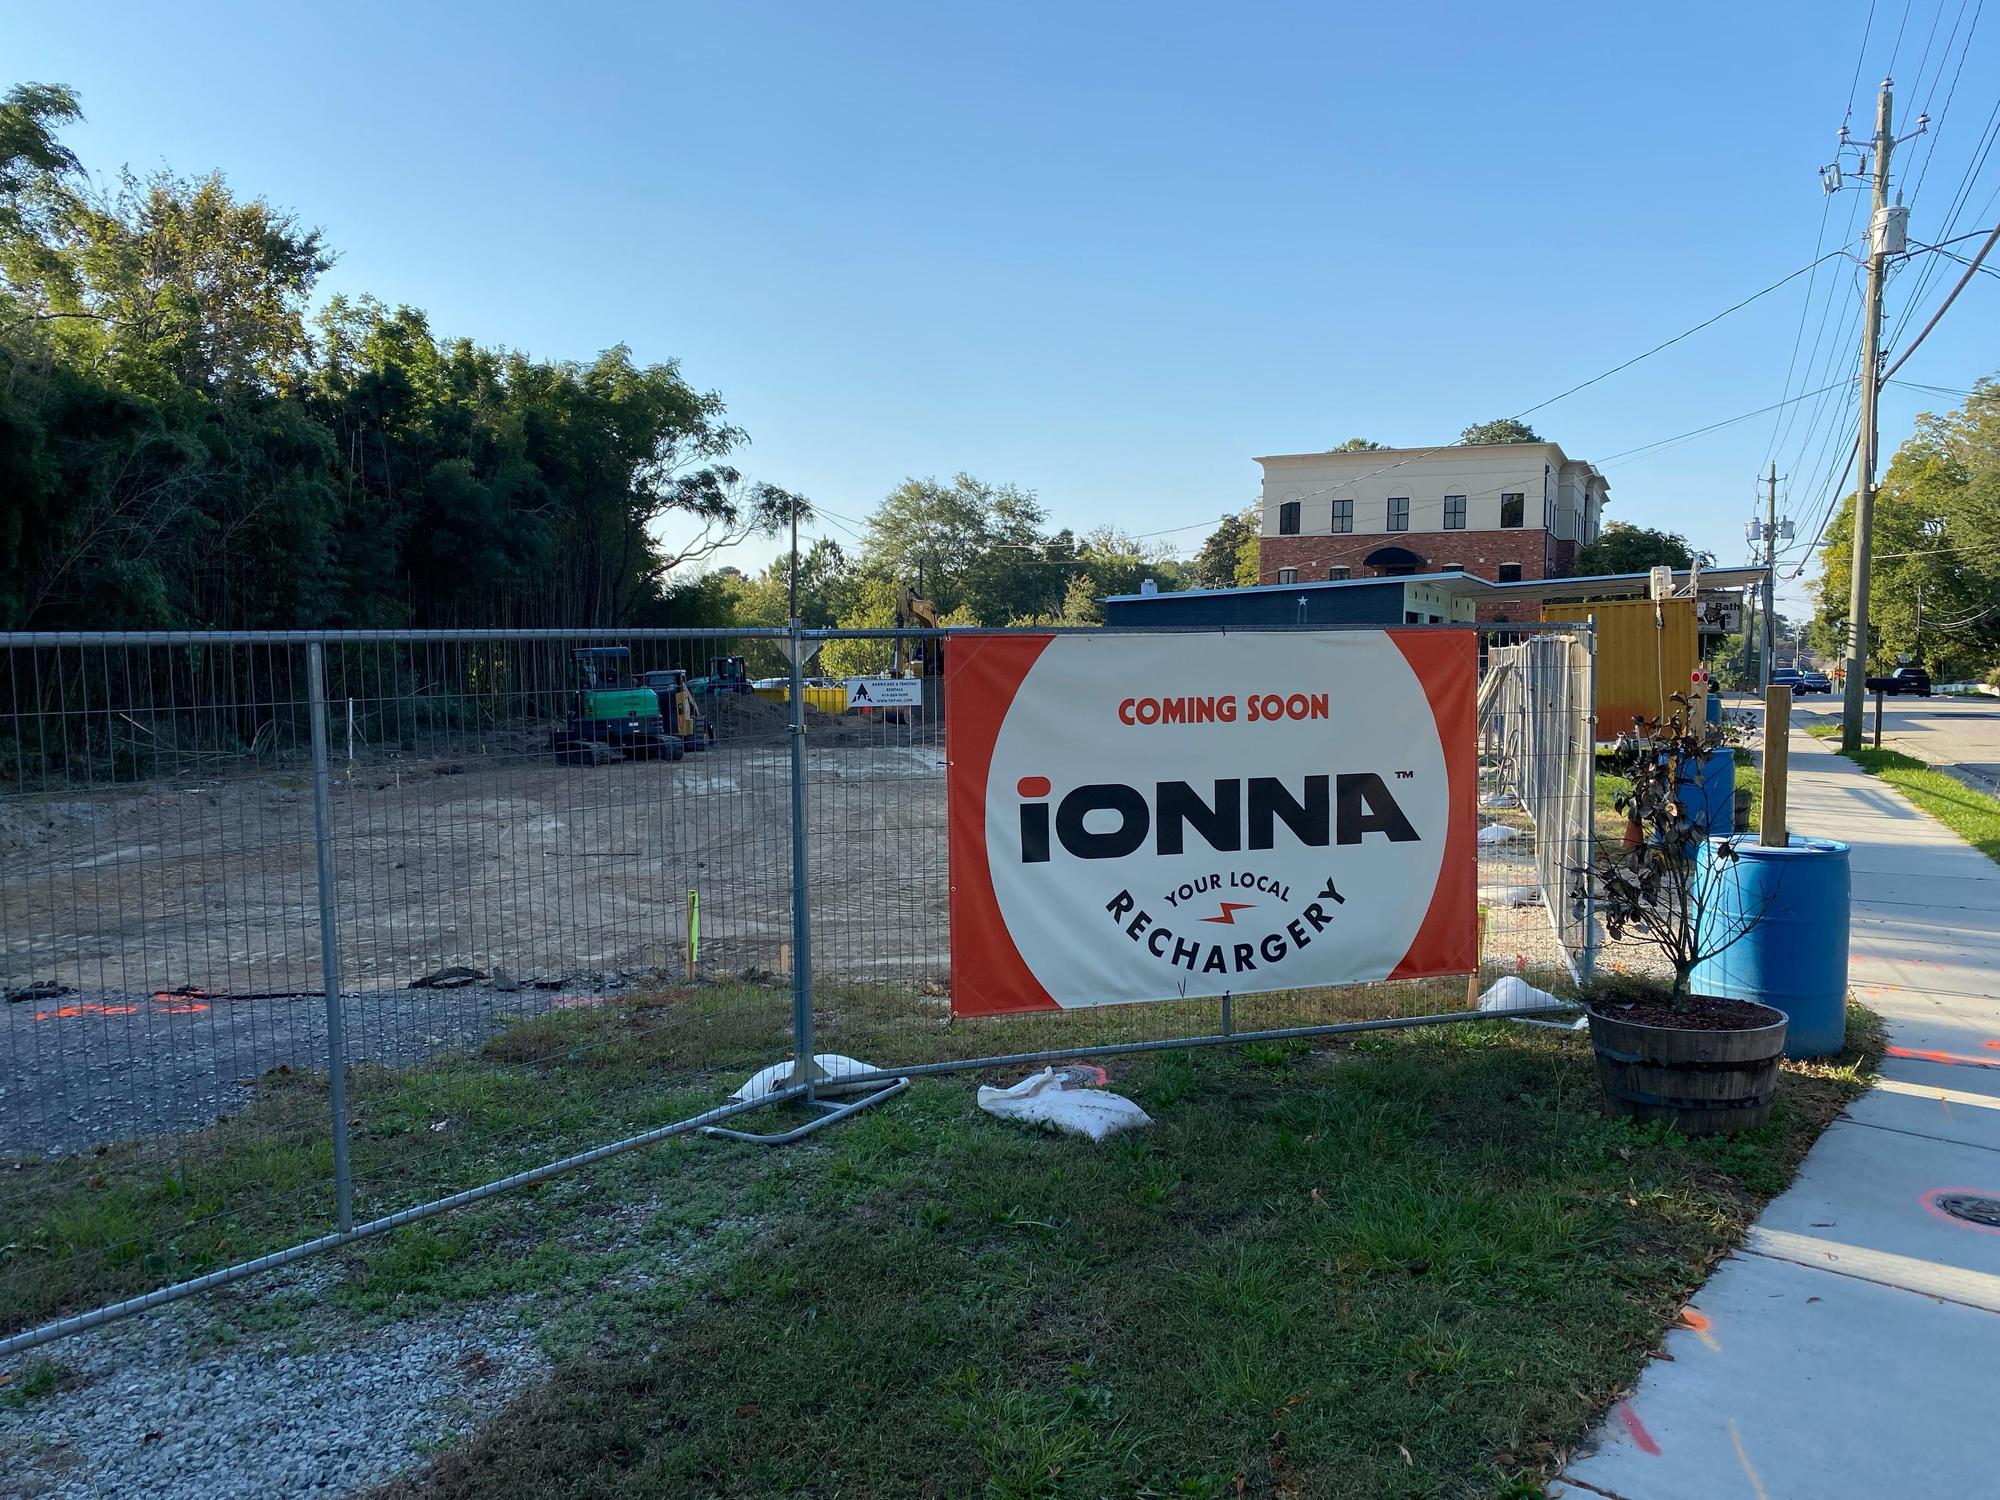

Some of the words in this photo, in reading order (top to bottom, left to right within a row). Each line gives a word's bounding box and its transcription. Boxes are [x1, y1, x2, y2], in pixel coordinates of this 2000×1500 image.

[1118, 694, 1237, 726] COMING
[1247, 693, 1329, 722] SOON
[1017, 773, 1422, 863] iONNA
[1164, 873, 1222, 908] YOUR
[1230, 871, 1291, 902] LOCAL
[1105, 876, 1346, 974] RECHARGERY
